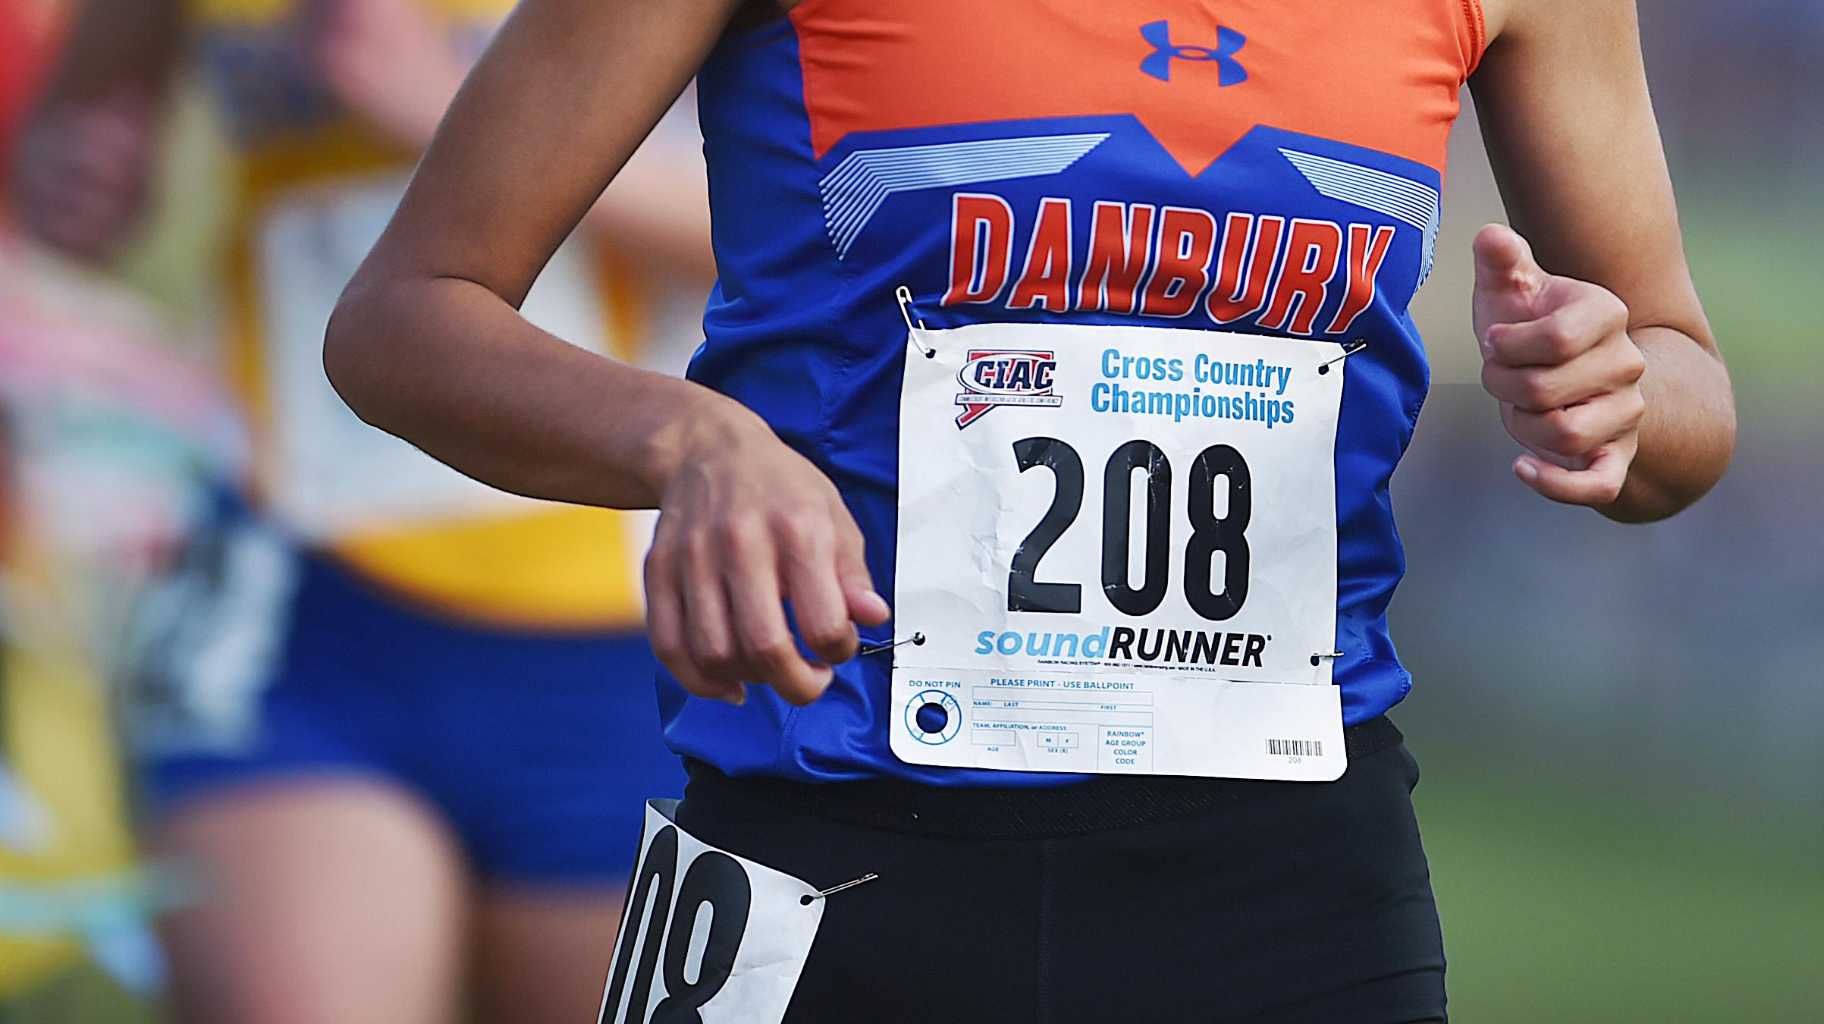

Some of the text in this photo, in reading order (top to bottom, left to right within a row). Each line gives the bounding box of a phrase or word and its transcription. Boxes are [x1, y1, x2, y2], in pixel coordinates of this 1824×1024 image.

[940, 192, 1396, 336] DANBURY
[973, 360, 1057, 390] CIAC
[1101, 348, 1292, 396] Cross Country
[1091, 382, 1295, 429] Championships
[1007, 436, 1252, 622] 208
[925, 680, 943, 688] NOT
[990, 678, 1025, 687] PLEASE
[1027, 679, 1056, 688] PRINT
[1063, 680, 1081, 689] USE
[1083, 681, 1134, 690] BALLPOINT
